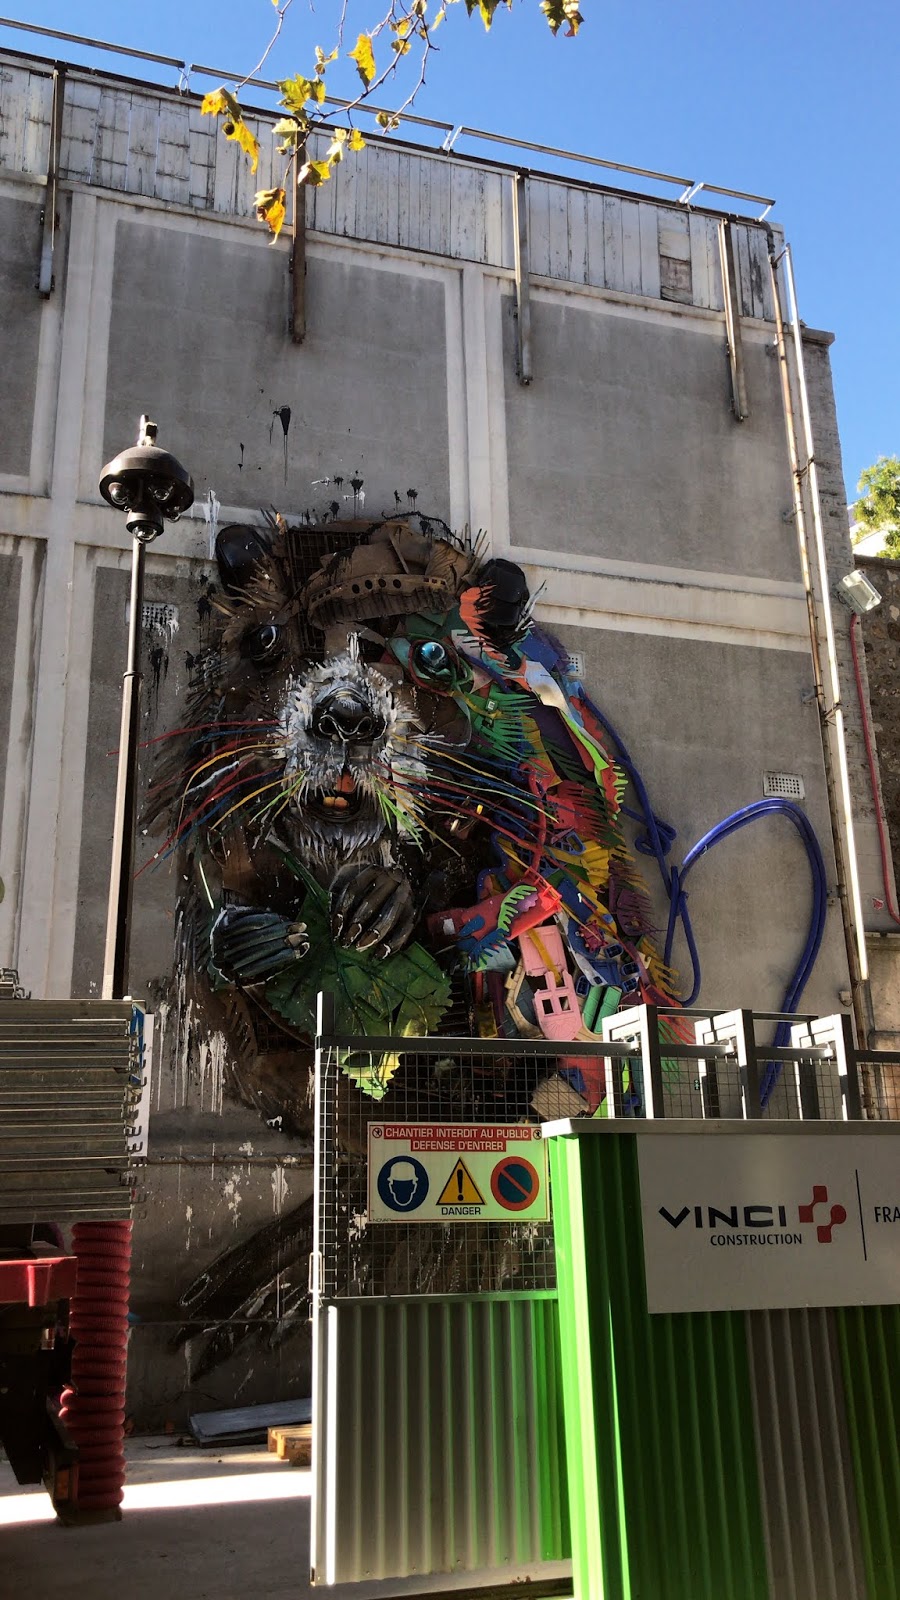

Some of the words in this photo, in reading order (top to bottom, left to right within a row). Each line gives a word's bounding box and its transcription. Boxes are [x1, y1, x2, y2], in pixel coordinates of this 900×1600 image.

[385, 1127, 434, 1138] CHANTIER
[436, 1128, 478, 1138] INTERDIT
[480, 1129, 494, 1138] AU
[496, 1129, 530, 1139] PUBLIC
[412, 1140, 456, 1150] DEFENSE
[458, 1141, 504, 1151] D'ENTRER
[441, 1206, 481, 1216] DANGER
[658, 1205, 787, 1229] VINCI
[710, 1233, 803, 1247] CONSTRUCTION
